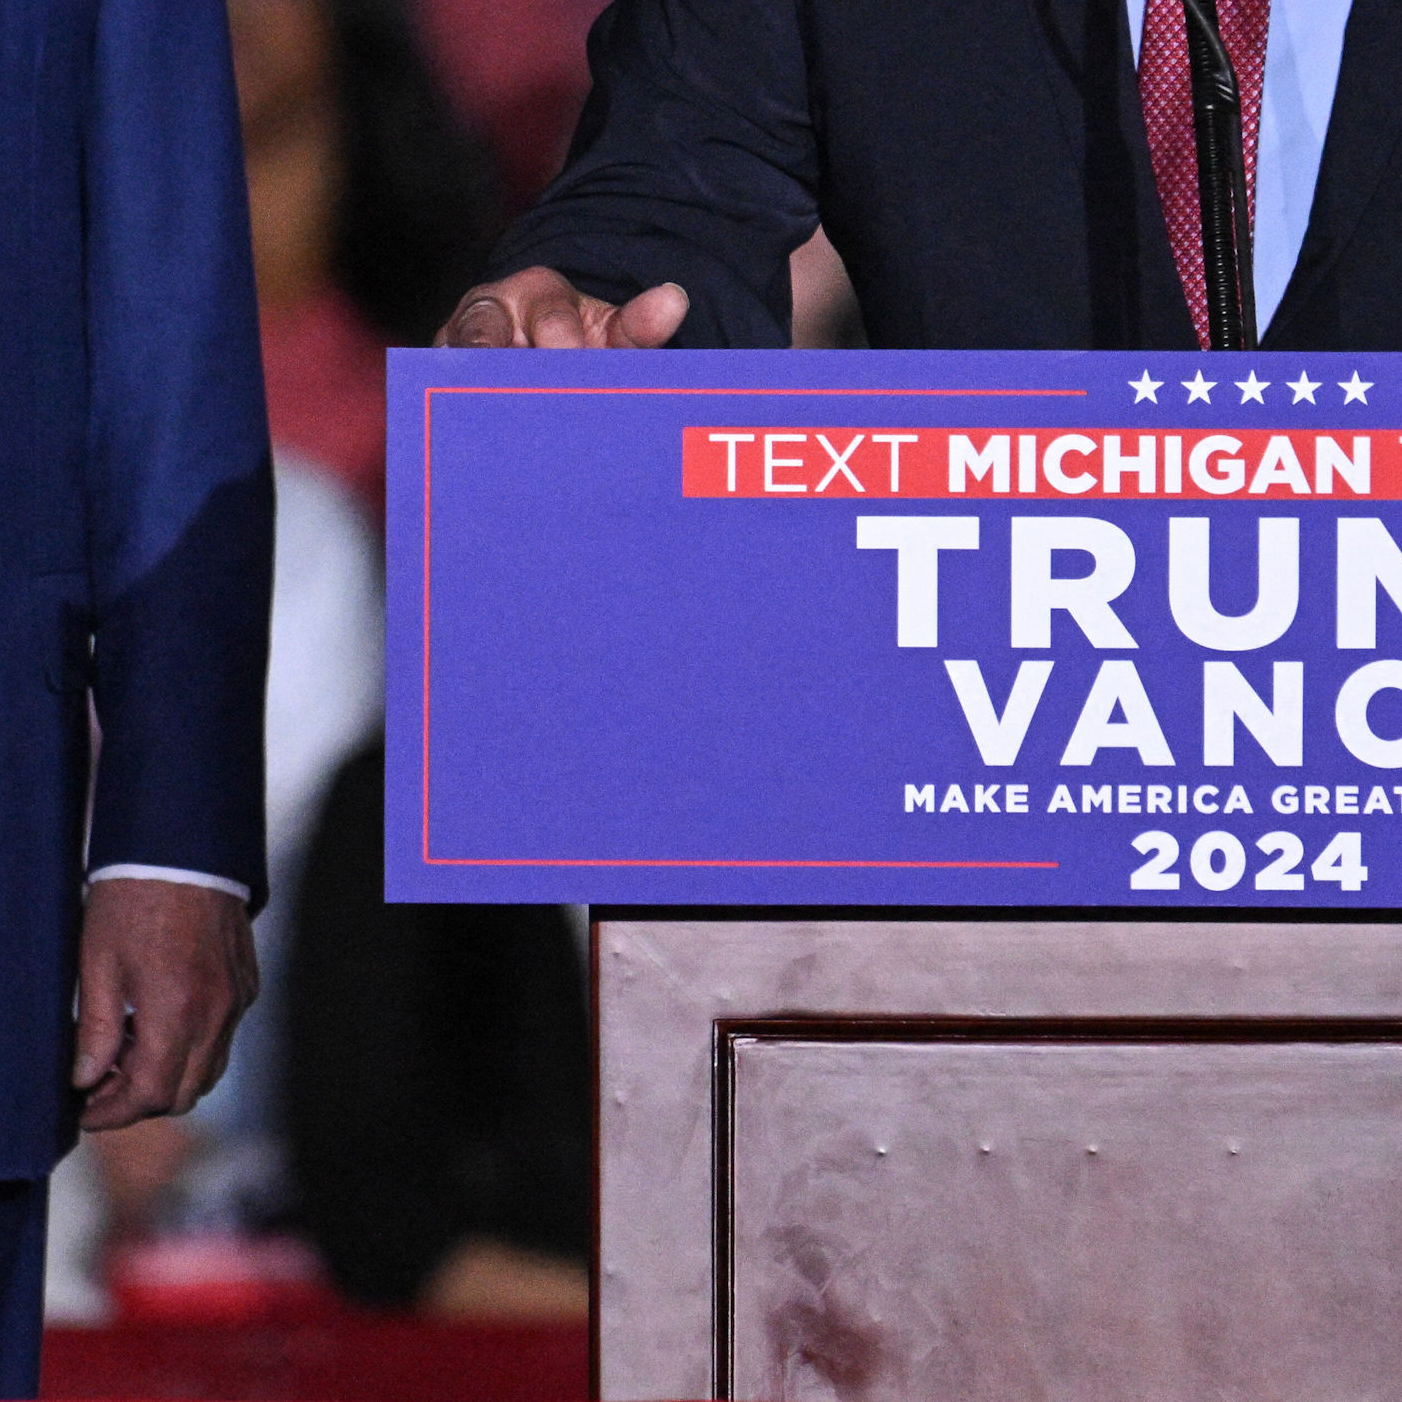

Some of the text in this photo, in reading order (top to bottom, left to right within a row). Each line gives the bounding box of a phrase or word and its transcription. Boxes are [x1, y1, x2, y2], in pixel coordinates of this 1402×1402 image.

[708, 434, 919, 493] TEXT
[948, 435, 1371, 495] MICHIGAN
[904, 783, 1029, 813] MAKE
[1047, 784, 1254, 814] AMERICA
[1130, 830, 1368, 892] 2024
